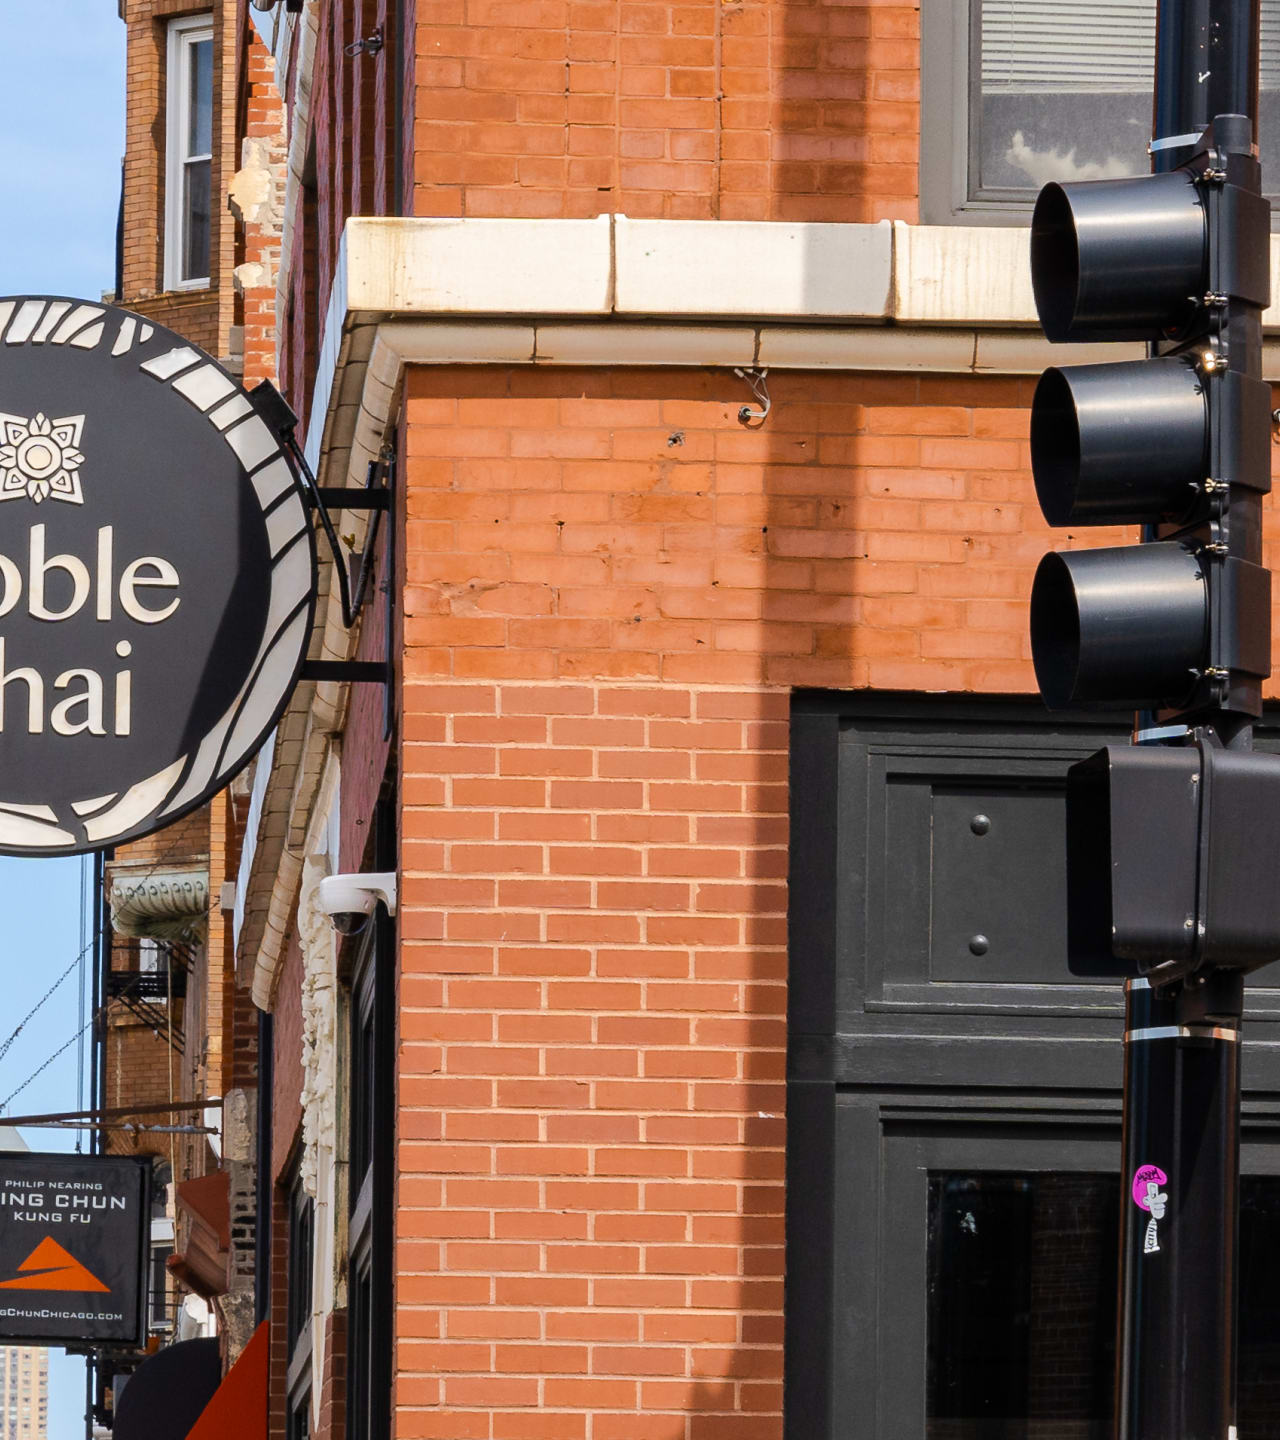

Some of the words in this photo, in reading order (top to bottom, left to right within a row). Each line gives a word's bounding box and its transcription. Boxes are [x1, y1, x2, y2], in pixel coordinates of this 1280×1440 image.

[5, 1179, 45, 1188] PHILIP
[48, 1181, 103, 1191] NEARING
[55, 1194, 126, 1210] CHUN
[14, 1211, 63, 1222] KUNG
[70, 1213, 91, 1224] FU
